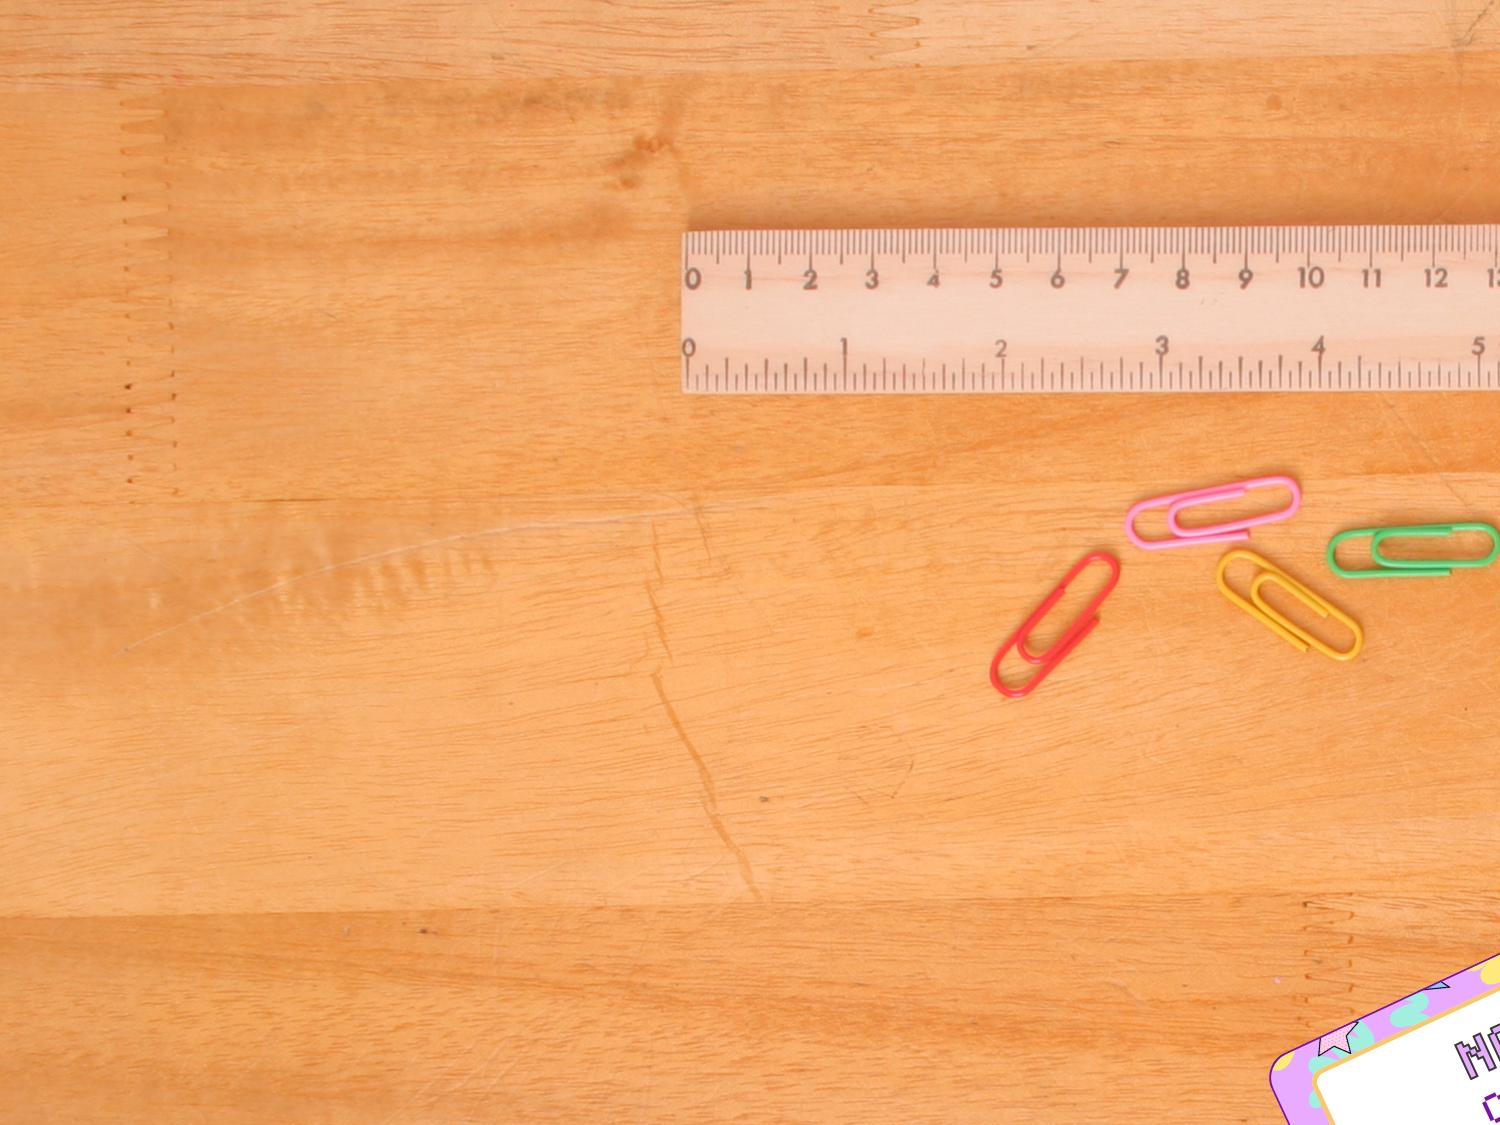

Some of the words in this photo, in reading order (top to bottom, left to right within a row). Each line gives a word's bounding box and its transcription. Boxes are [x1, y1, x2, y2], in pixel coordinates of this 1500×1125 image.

[684, 268, 703, 290] 0
[743, 269, 753, 290] 1
[802, 268, 819, 290] 2
[864, 268, 880, 290] 3
[926, 268, 941, 289] 4
[989, 267, 1004, 289] 5
[1049, 267, 1066, 290] 6
[1113, 268, 1130, 290] 7
[1174, 267, 1191, 290] 8
[1237, 268, 1255, 290] 9
[1297, 266, 1325, 290] 10
[1361, 268, 1382, 289] 11
[1424, 267, 1449, 289] 12
[682, 337, 697, 357] 0
[840, 337, 848, 356] 1
[994, 339, 1008, 358] 2
[1154, 335, 1170, 357] 3
[1310, 335, 1327, 356] 4
[1471, 335, 1486, 356] 5
